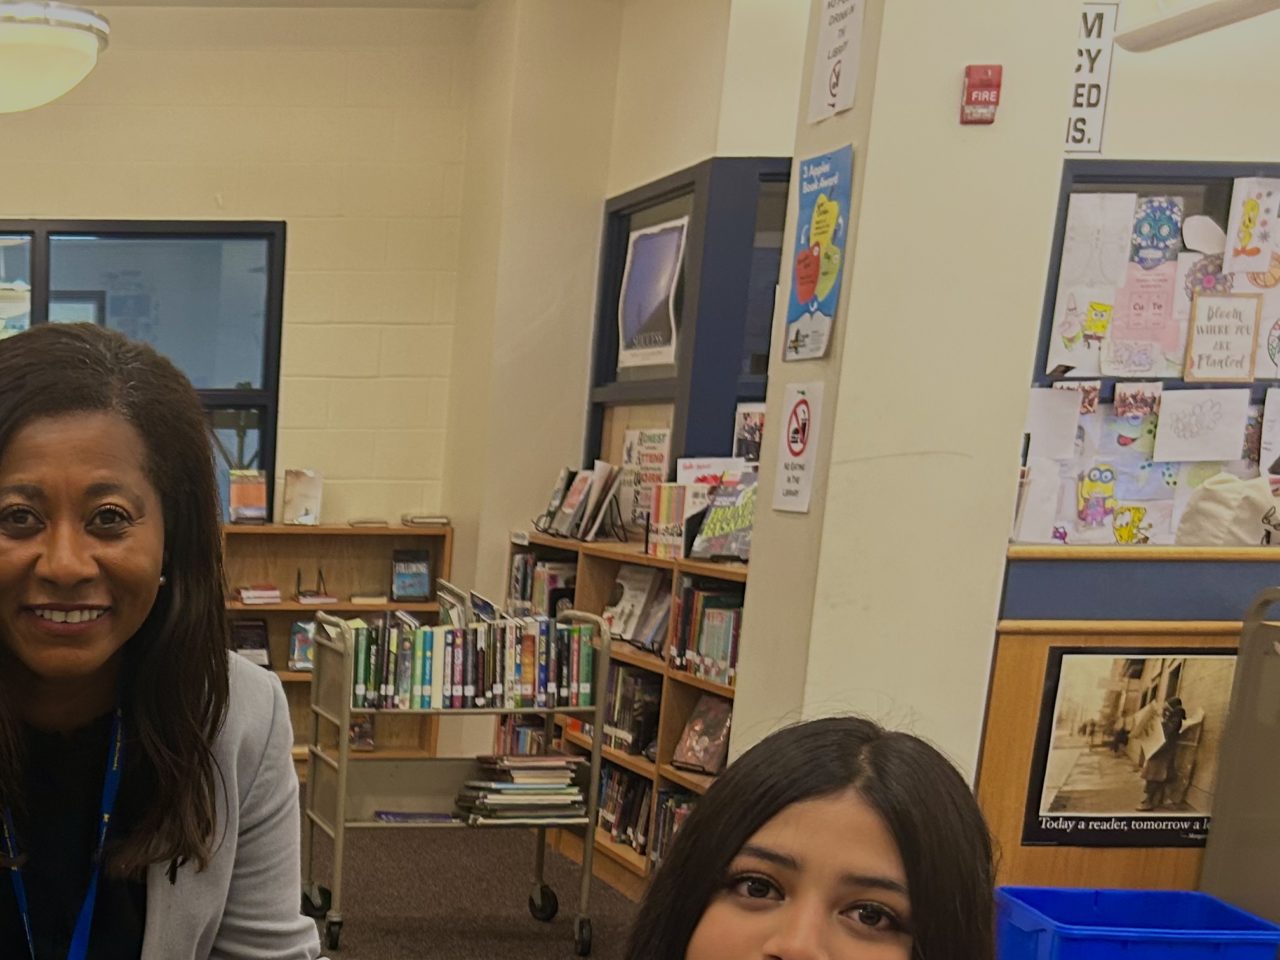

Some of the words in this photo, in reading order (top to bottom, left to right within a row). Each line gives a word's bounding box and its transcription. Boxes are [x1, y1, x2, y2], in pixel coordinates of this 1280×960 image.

[971, 91, 997, 102] FIRE
[1065, 117, 1091, 144] S.
[802, 181, 818, 194] Book
[818, 172, 840, 190] Award
[1212, 340, 1231, 351] ARE
[1039, 816, 1075, 832] Today
[1077, 820, 1085, 829] a
[1088, 818, 1128, 831] reader,
[1131, 819, 1191, 830] tomorrow
[1193, 820, 1200, 829] a
